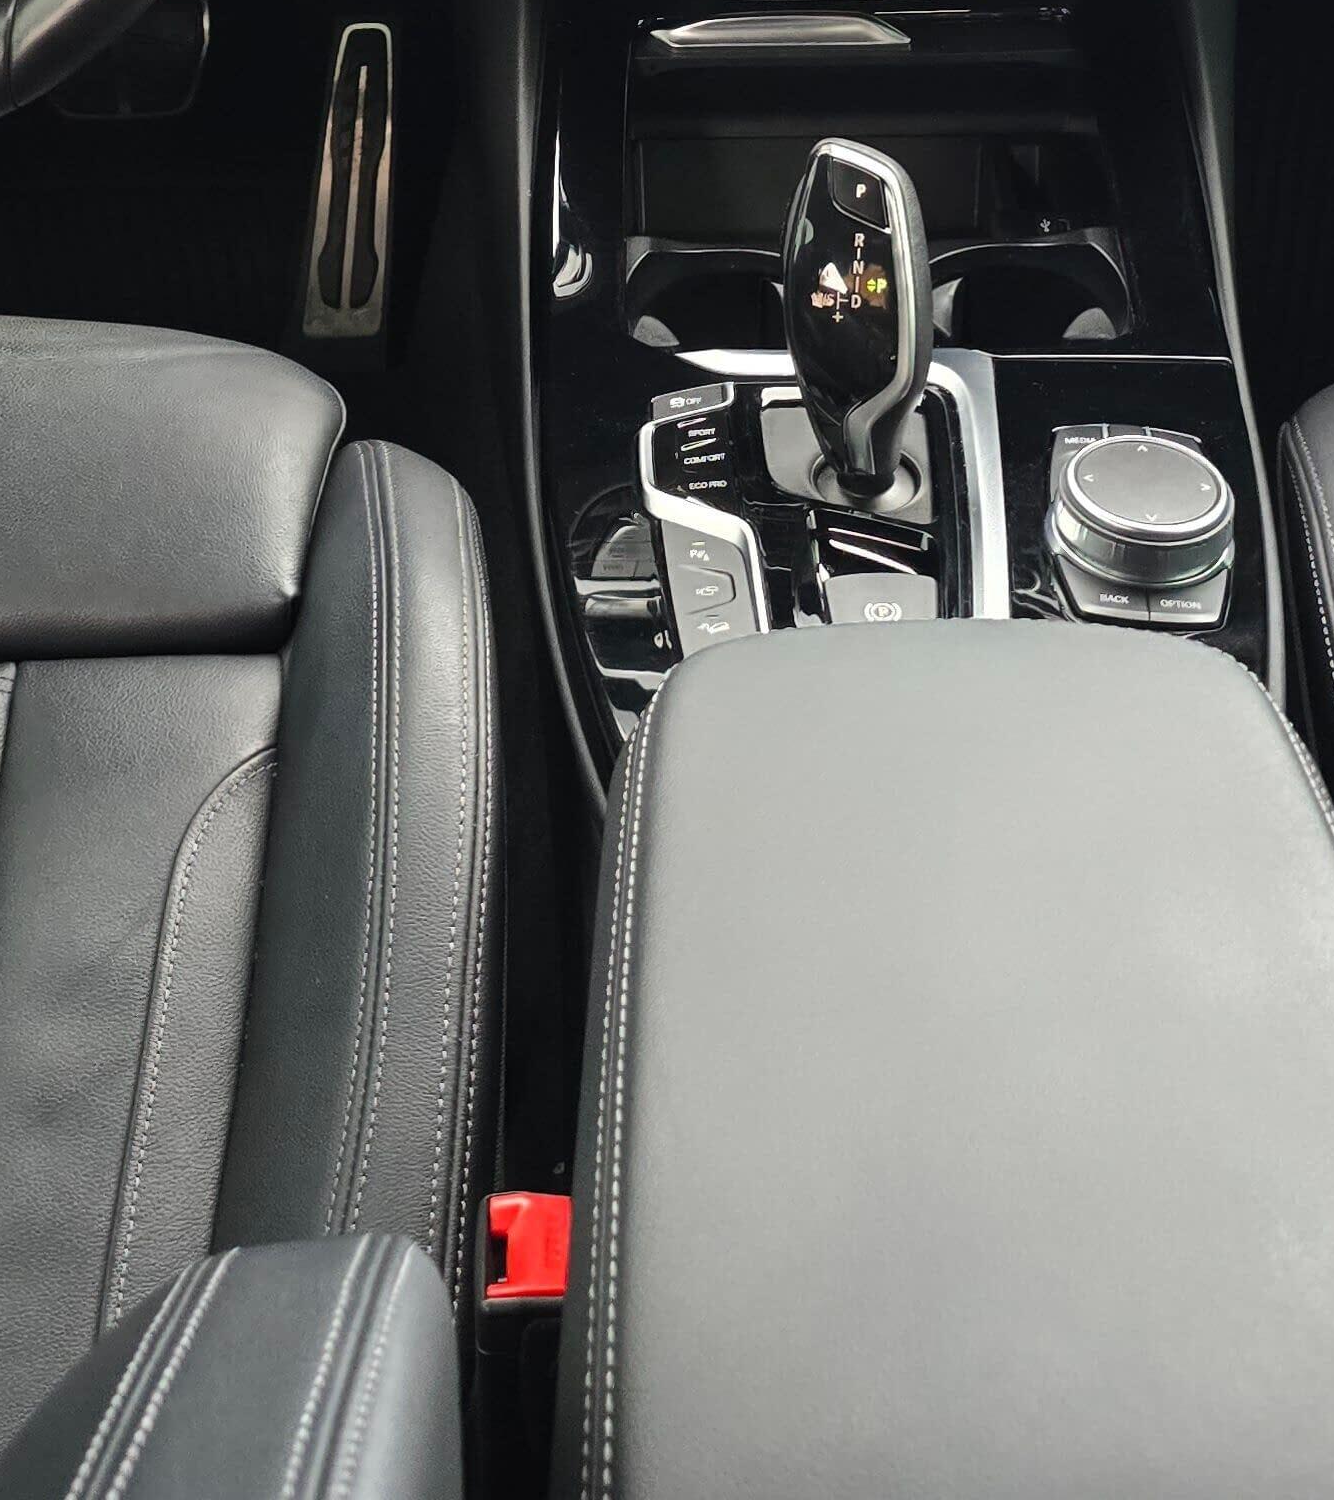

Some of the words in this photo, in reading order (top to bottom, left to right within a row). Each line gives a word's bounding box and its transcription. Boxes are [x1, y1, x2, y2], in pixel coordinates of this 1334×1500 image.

[855, 183, 867, 198] P
[854, 232, 865, 248] R
[852, 260, 864, 275] N
[850, 295, 862, 309] D
[688, 427, 716, 438] SPORT
[683, 452, 725, 465] COMFORT
[1099, 593, 1130, 604] BACK
[1160, 598, 1202, 610] OPTION
